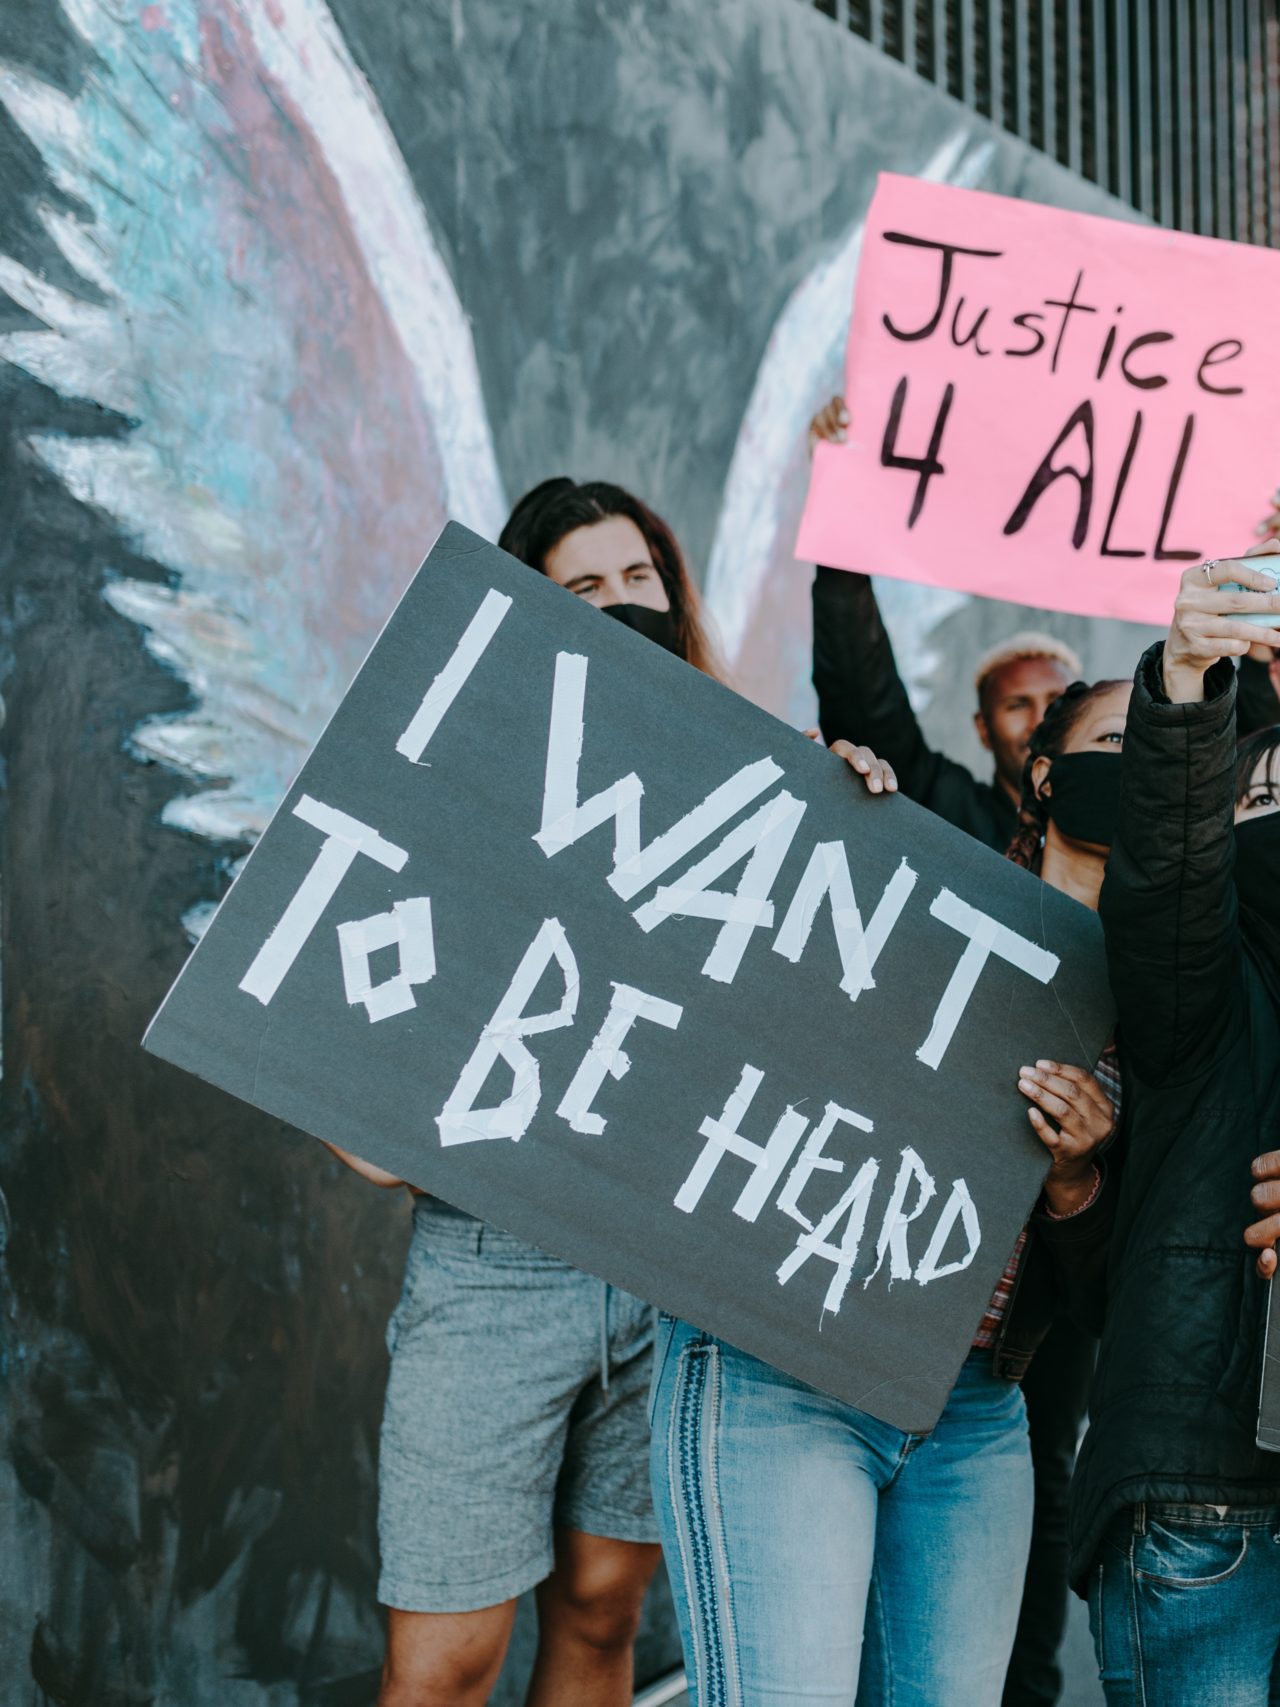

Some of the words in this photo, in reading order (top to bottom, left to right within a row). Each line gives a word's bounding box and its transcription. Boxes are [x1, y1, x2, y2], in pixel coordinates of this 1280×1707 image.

[882, 231, 1245, 395] Justice
[880, 375, 954, 531] 4
[1003, 399, 1203, 561] ALL
[396, 588, 513, 766] I
[532, 650, 1061, 1070] WANT
[434, 916, 683, 1147] BE
[673, 1063, 983, 1316] HEARD
